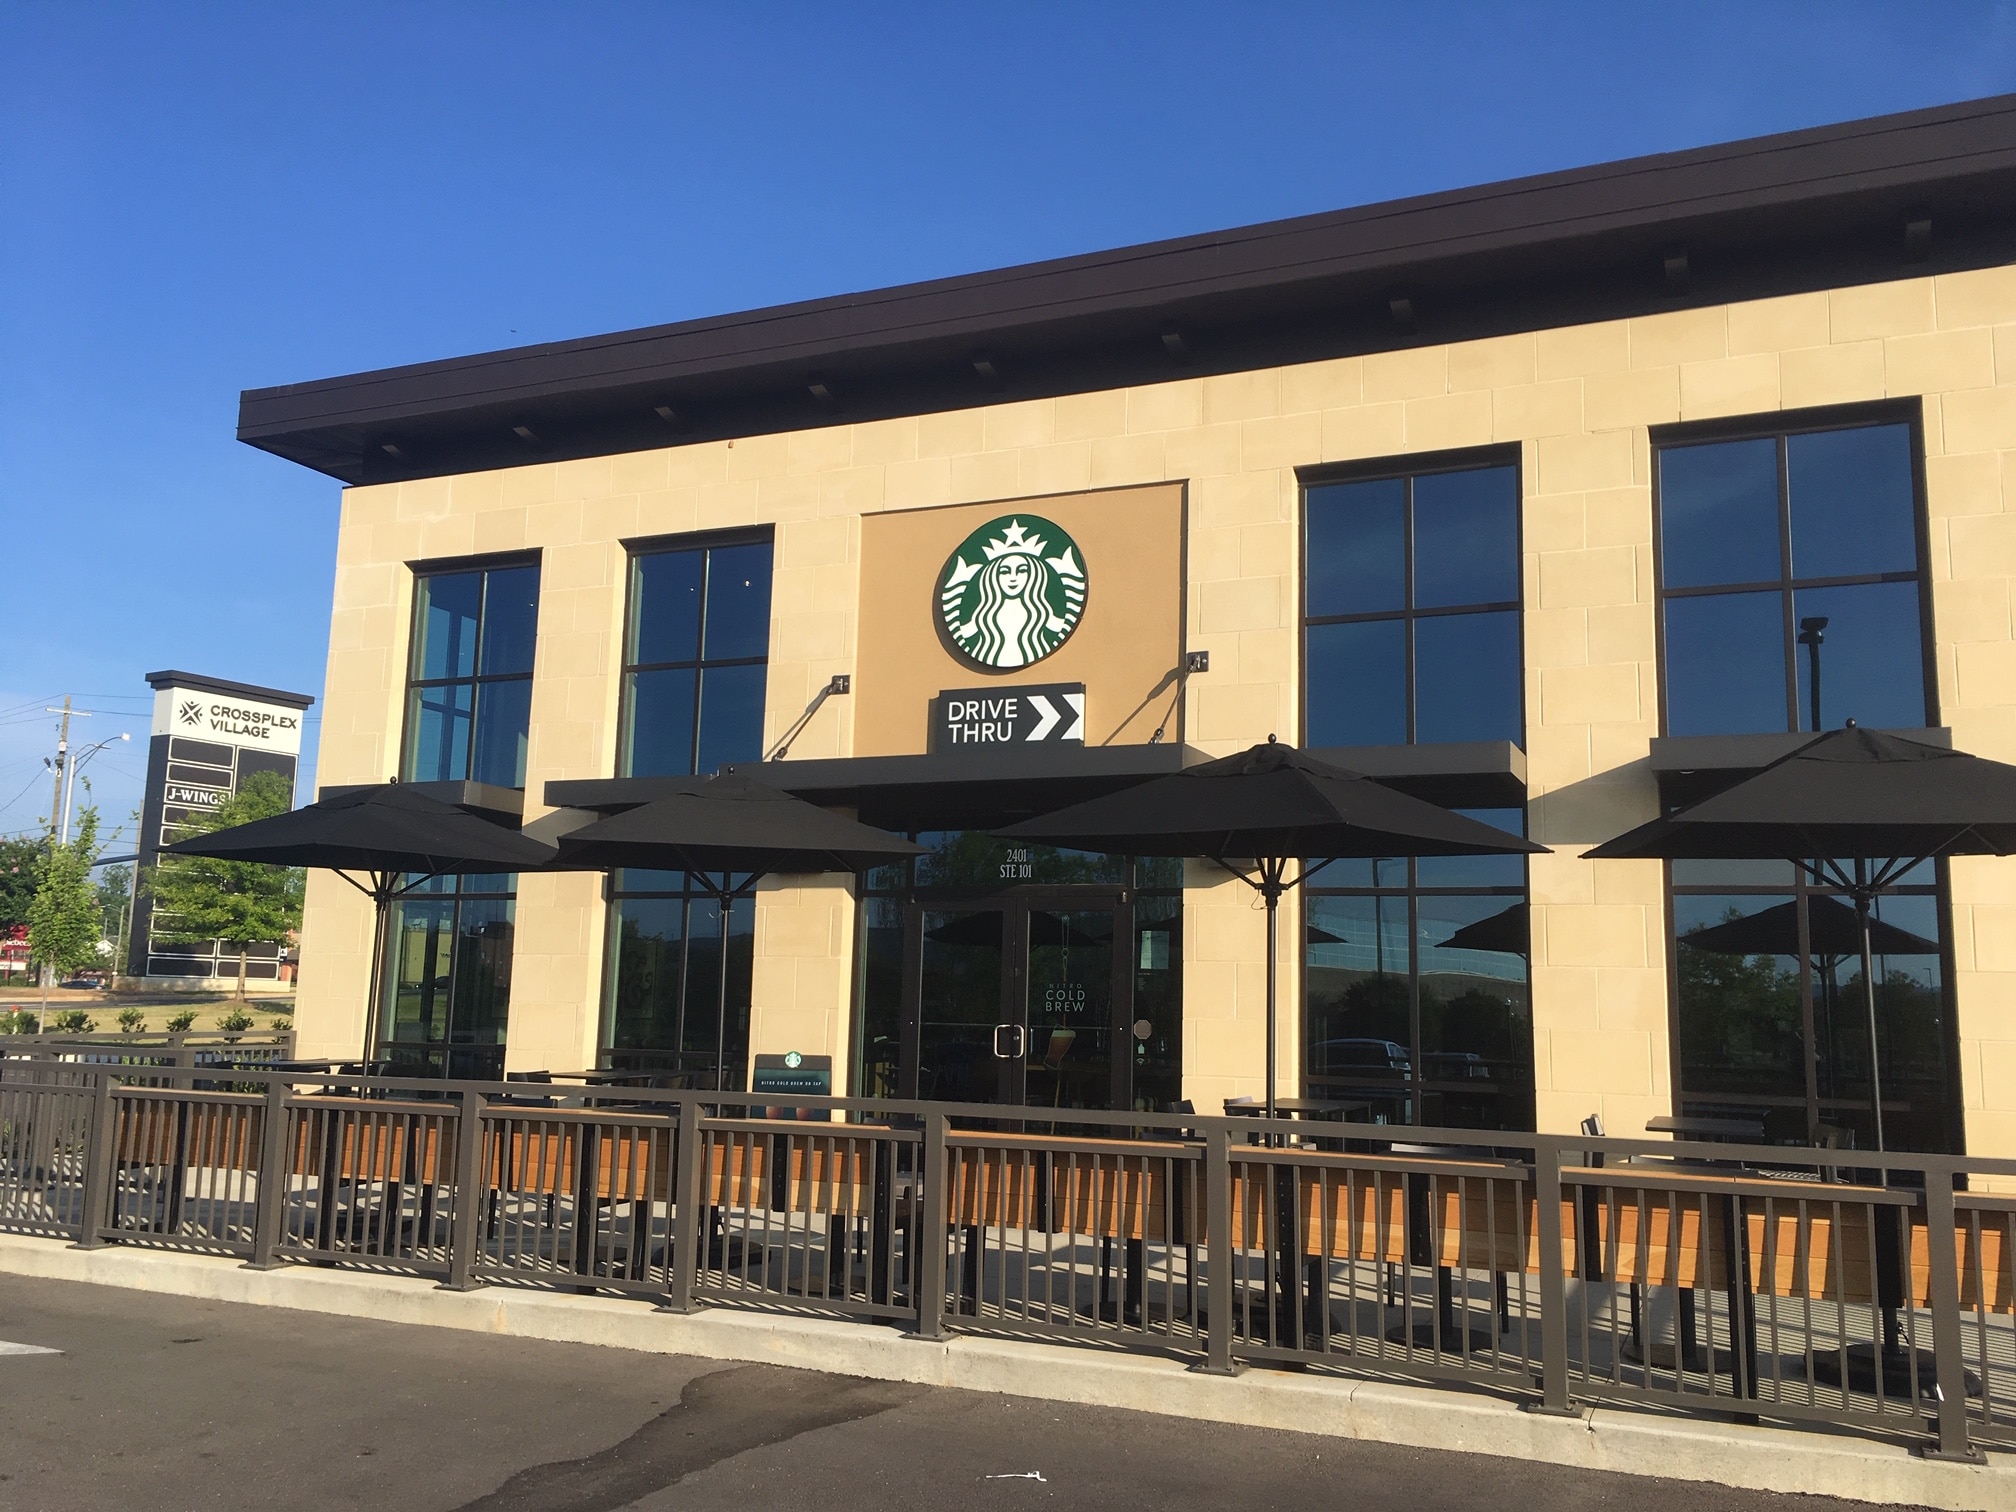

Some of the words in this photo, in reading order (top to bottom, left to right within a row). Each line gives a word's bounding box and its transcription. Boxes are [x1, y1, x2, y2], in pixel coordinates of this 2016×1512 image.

[210, 705, 297, 729] CROSSPLEX
[948, 698, 1018, 721] DRIVE
[210, 719, 270, 739] VILLAGE
[948, 721, 1012, 744] THRU
[168, 788, 226, 805] J-WINGS
[1006, 848, 1027, 862] 2401
[1000, 864, 1017, 878] STE
[1019, 864, 1032, 878] 101
[1045, 990, 1085, 1001] COLD
[1045, 1001, 1085, 1012] BREW
